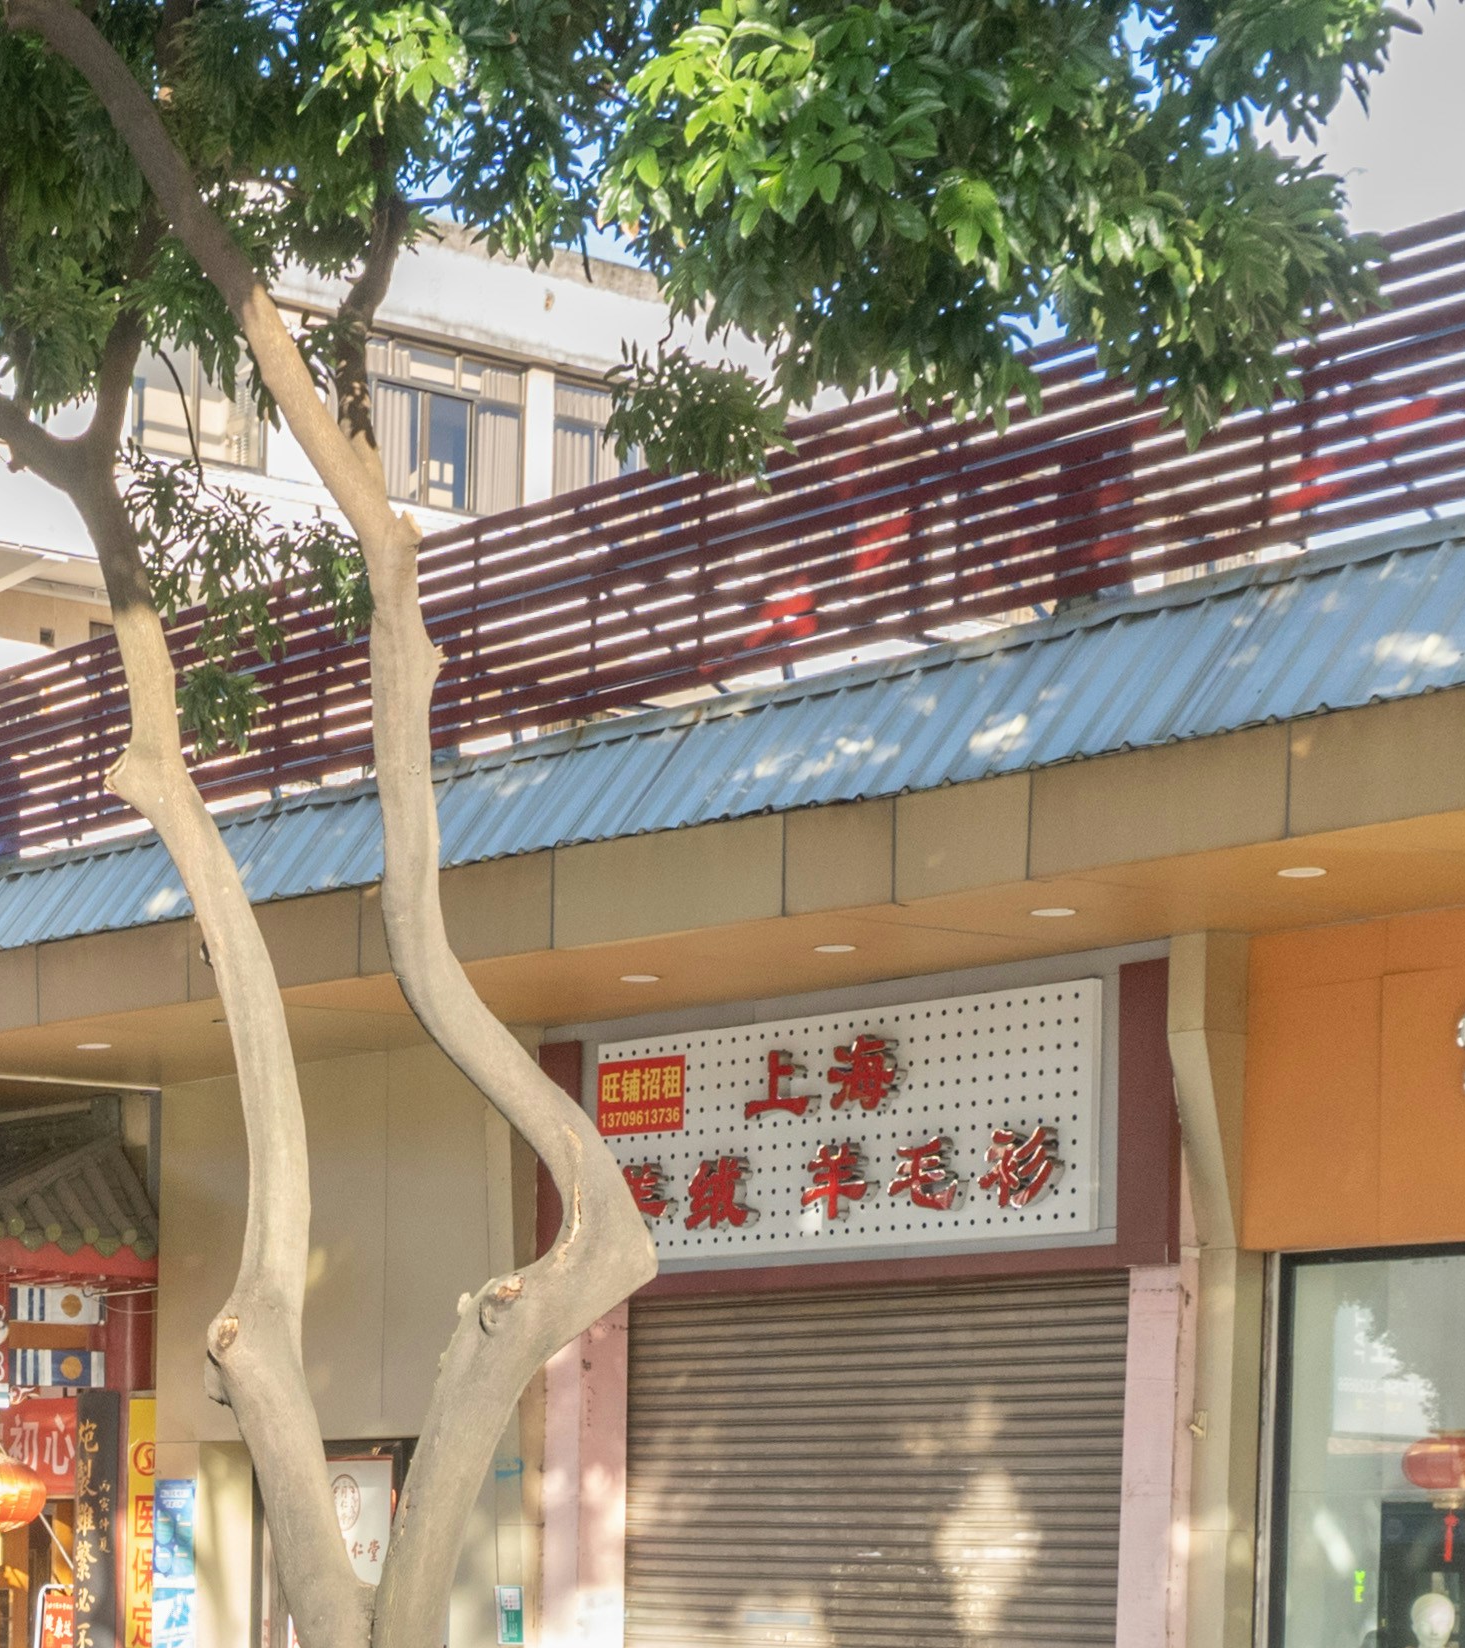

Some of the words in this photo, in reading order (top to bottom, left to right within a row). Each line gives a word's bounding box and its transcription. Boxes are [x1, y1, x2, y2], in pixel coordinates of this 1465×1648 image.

[601, 1066, 682, 1103] 旺铺招租
[744, 1033, 910, 1123] 上海
[601, 1107, 680, 1128] 13709613736
[801, 1125, 1065, 1221] 羊毛衫
[343, 1537, 382, 1562] 仁堂
